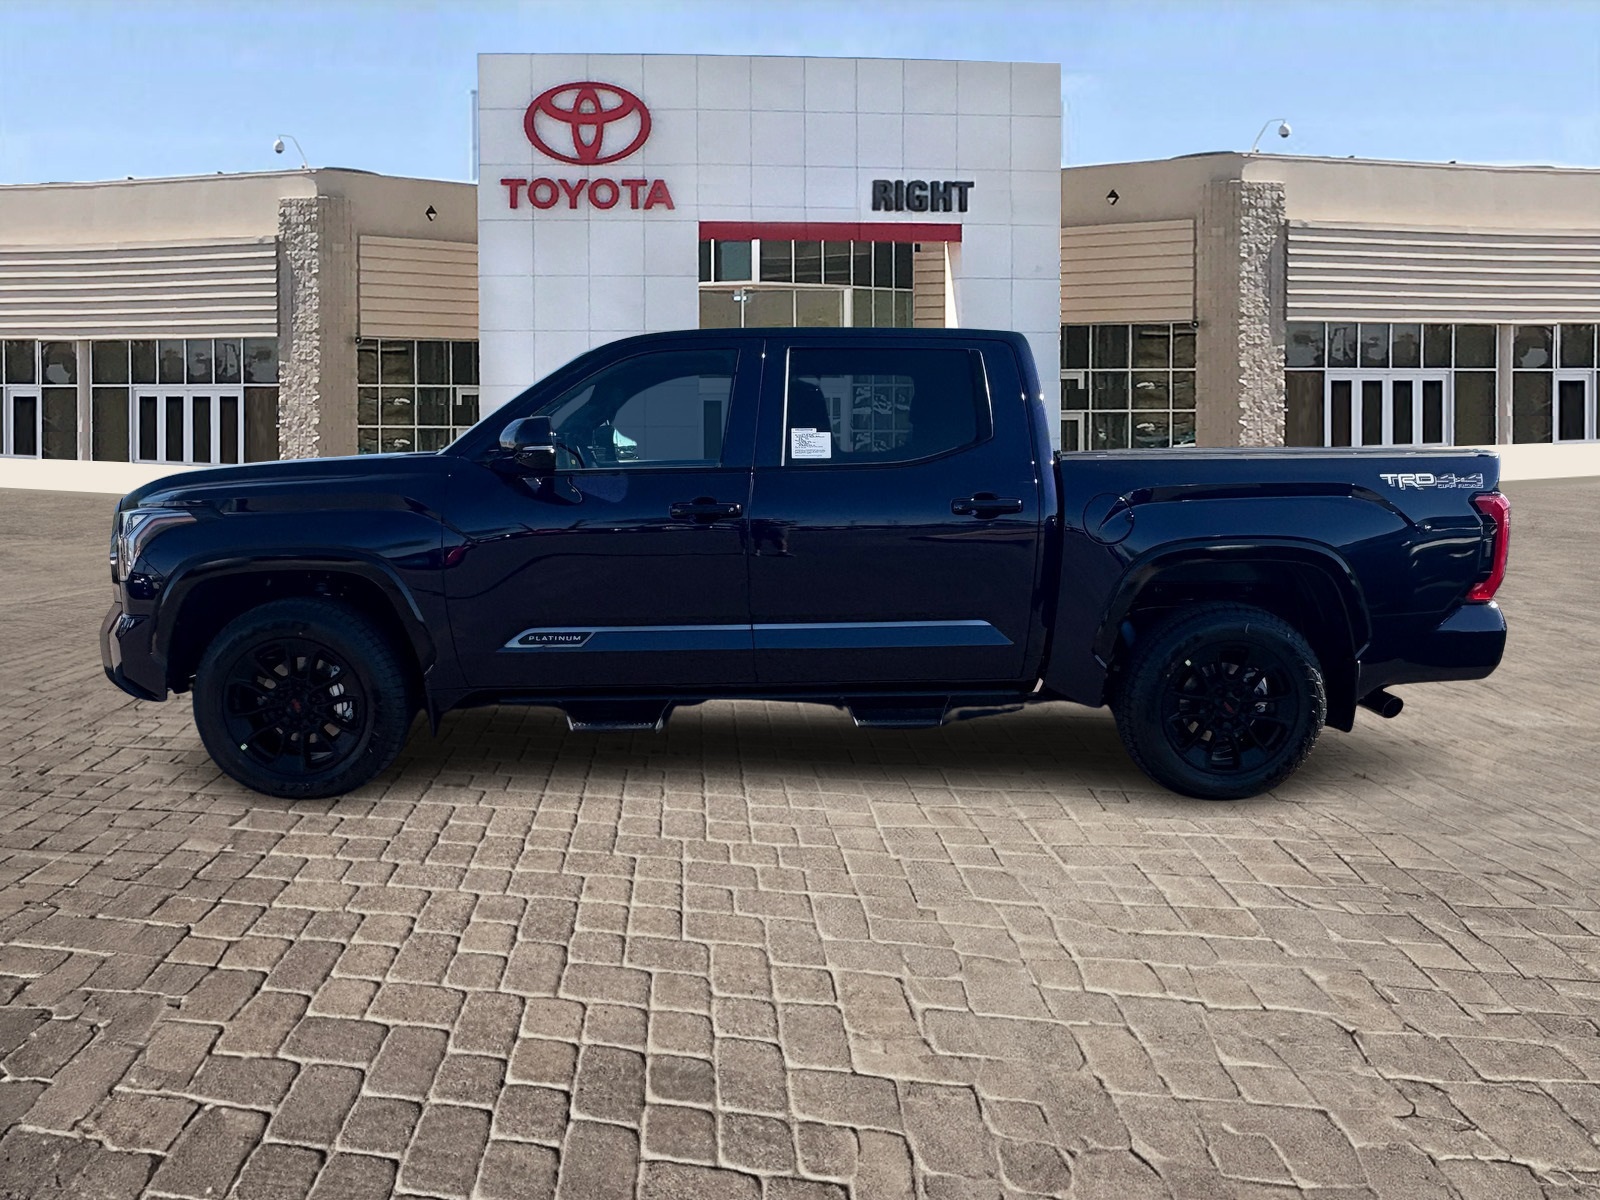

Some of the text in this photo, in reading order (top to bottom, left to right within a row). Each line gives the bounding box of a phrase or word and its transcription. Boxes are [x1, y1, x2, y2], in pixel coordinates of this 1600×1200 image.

[500, 178, 675, 210] TOYOTA
[871, 179, 975, 213] RIGHT
[1379, 473, 1437, 490] TRD
